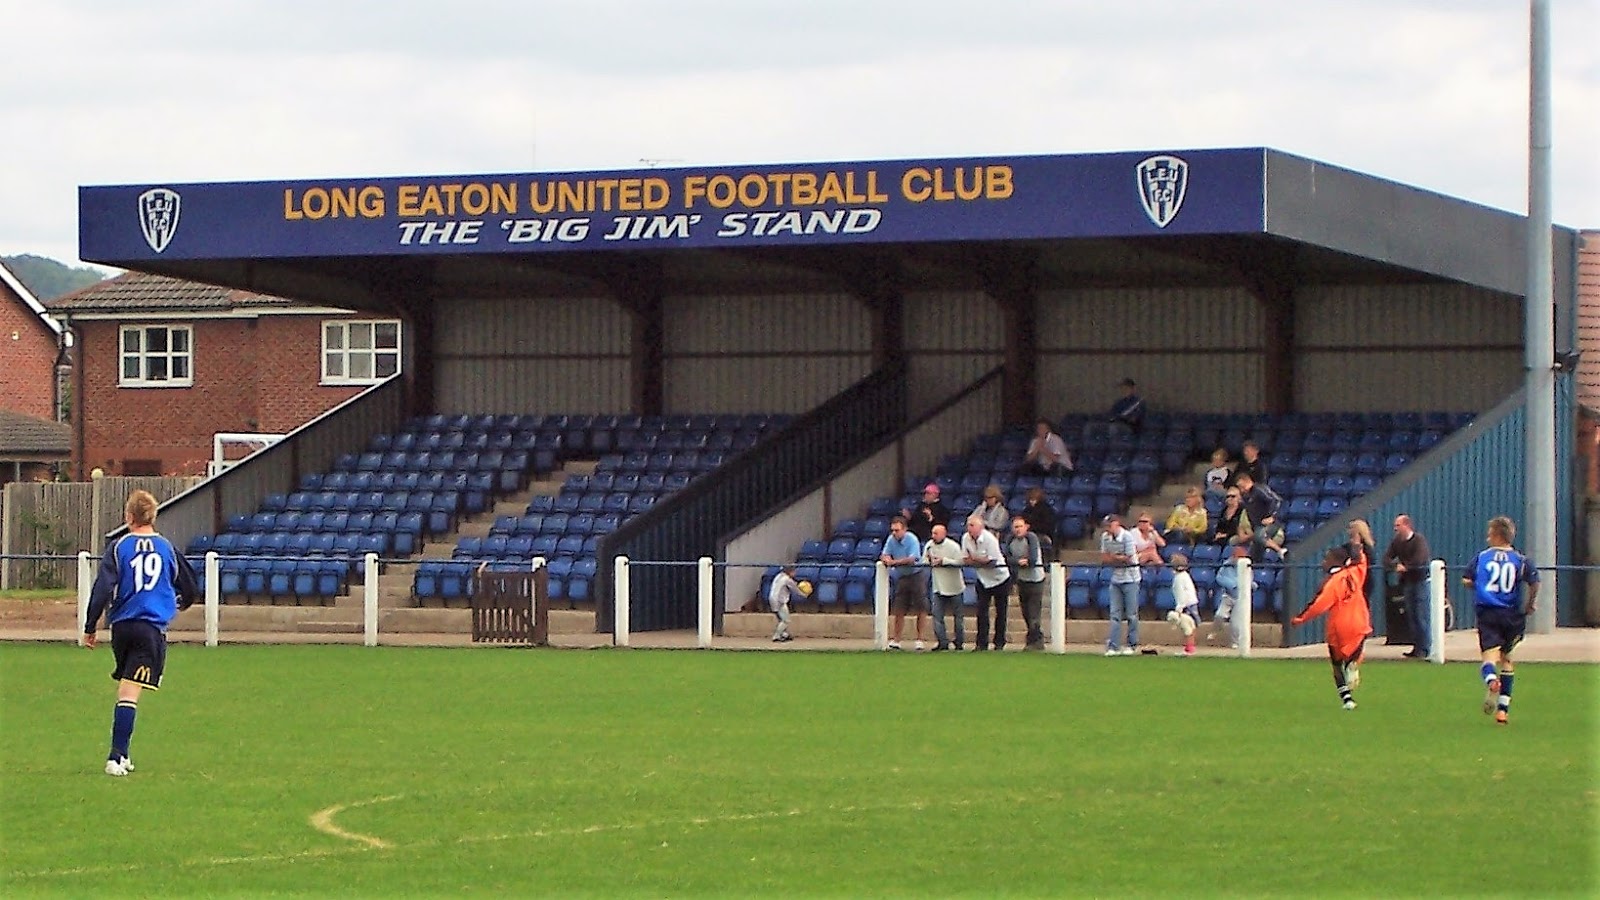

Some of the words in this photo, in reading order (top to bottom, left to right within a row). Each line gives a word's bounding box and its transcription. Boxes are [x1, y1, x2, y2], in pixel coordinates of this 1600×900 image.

[284, 186, 385, 220] LONG
[397, 183, 518, 217] EATON
[530, 177, 671, 214] UNITED
[684, 171, 889, 209] FOOTBALL
[902, 166, 1014, 202] CLUB
[399, 220, 484, 245] THE
[717, 209, 882, 237] STAND
[129, 552, 162, 593] 19
[1485, 560, 1516, 593] 20
